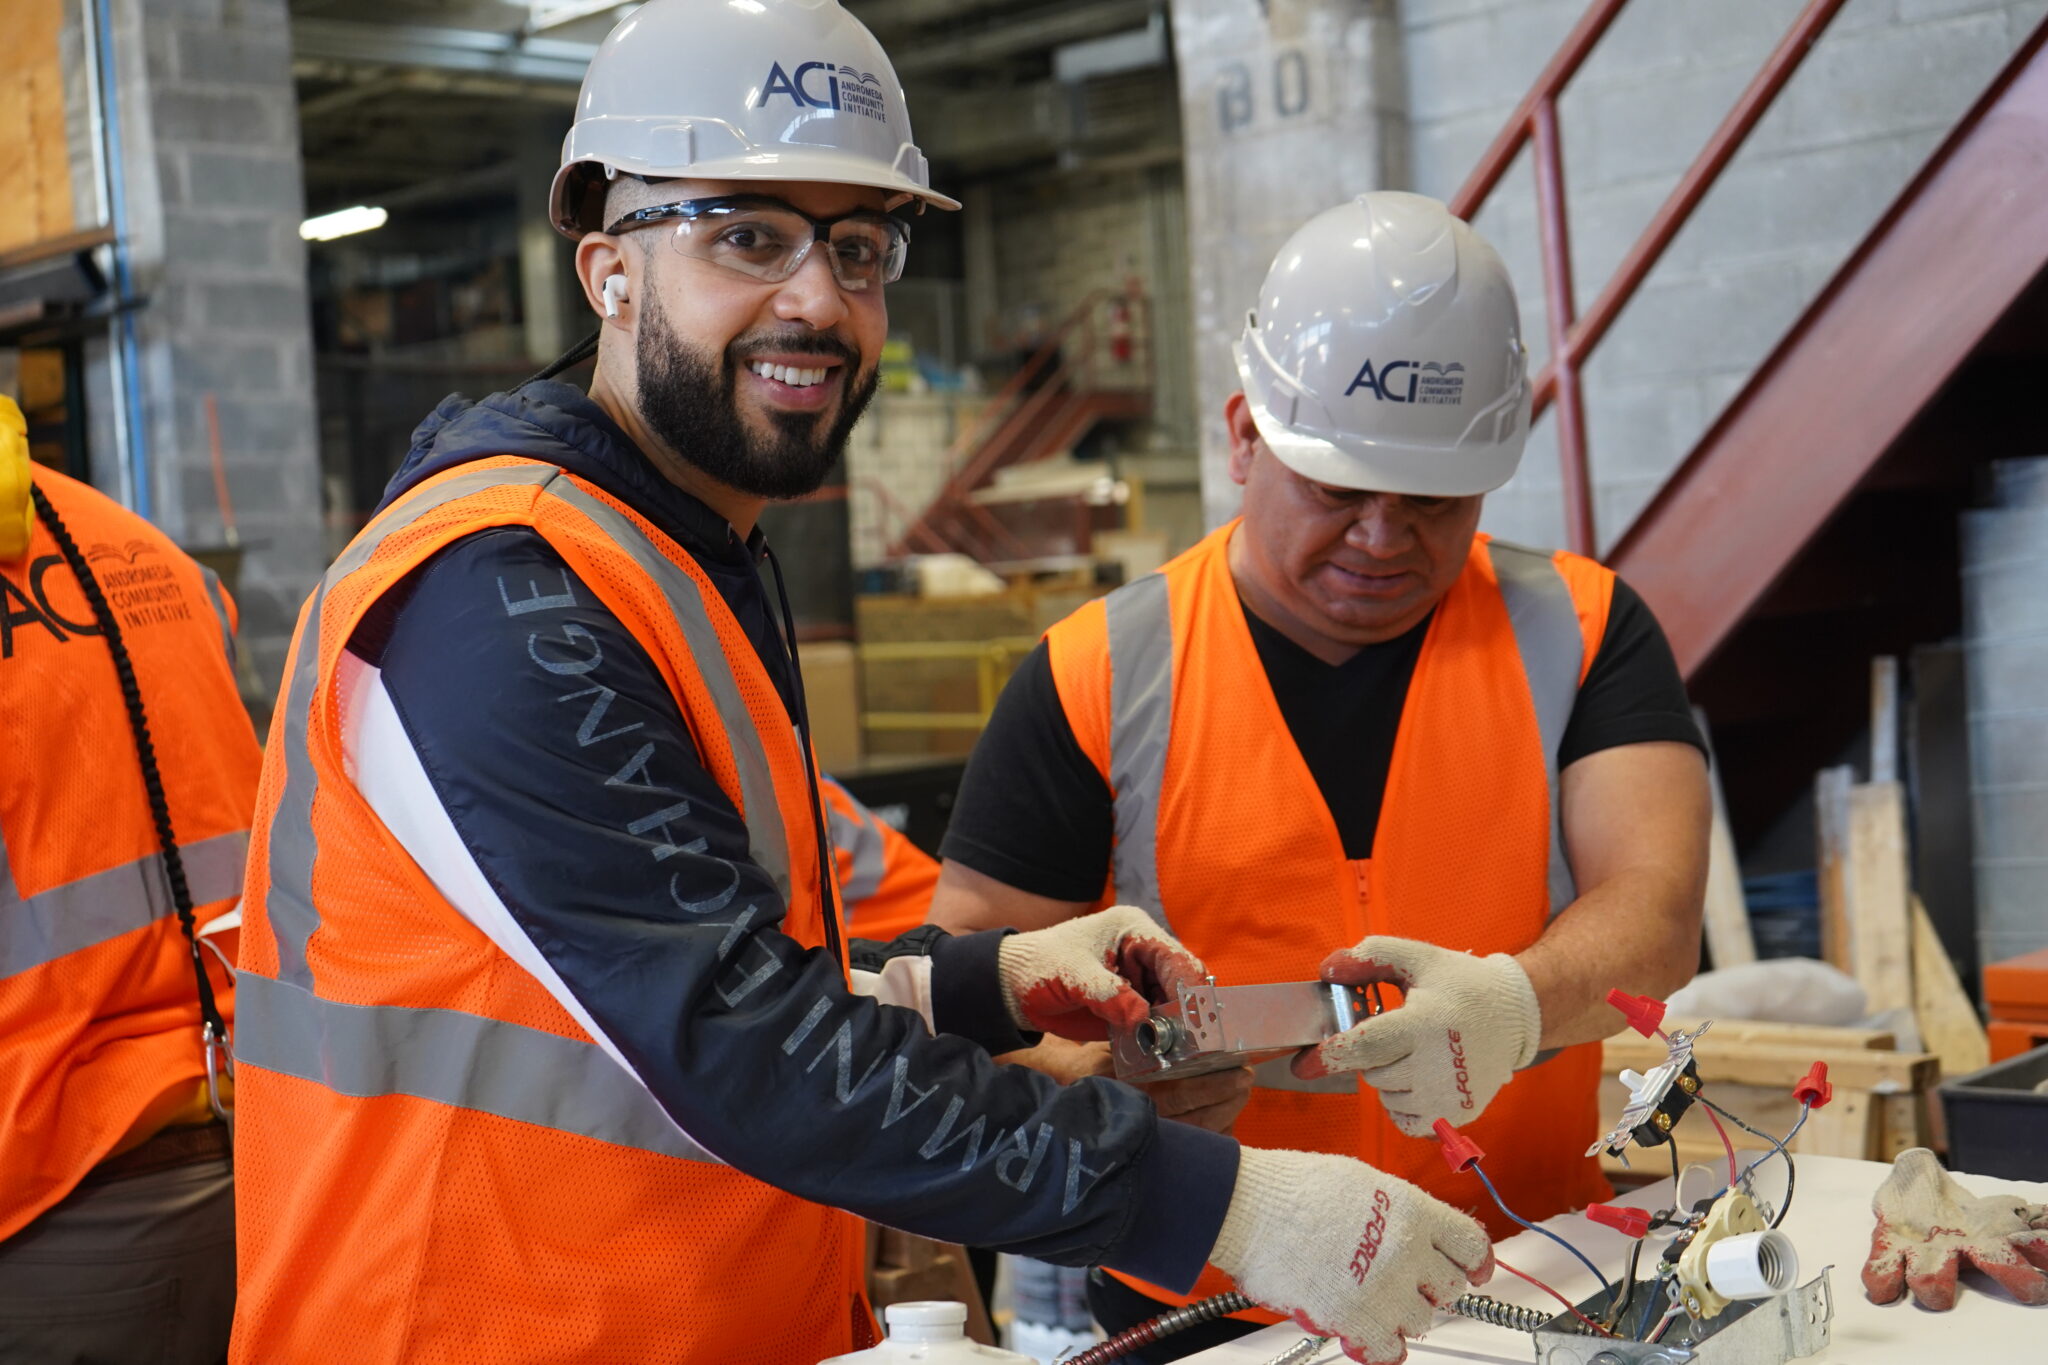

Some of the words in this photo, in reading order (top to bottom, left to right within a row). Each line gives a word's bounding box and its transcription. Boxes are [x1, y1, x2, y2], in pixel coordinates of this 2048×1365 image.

[841, 81, 884, 101] ANDROMEDA
[842, 91, 885, 112] COMMUNITY
[844, 102, 887, 124] INITIATIVE
[1418, 395, 1462, 406] INITIATIVE
[1419, 385, 1463, 395] COMMUNITY
[0, 554, 107, 660] AC
[111, 583, 183, 610] COMMUNITY
[123, 602, 193, 630] INITIATIVE
[496, 567, 785, 1009] EXCHANGE
[781, 994, 1117, 1217] ARMANI
